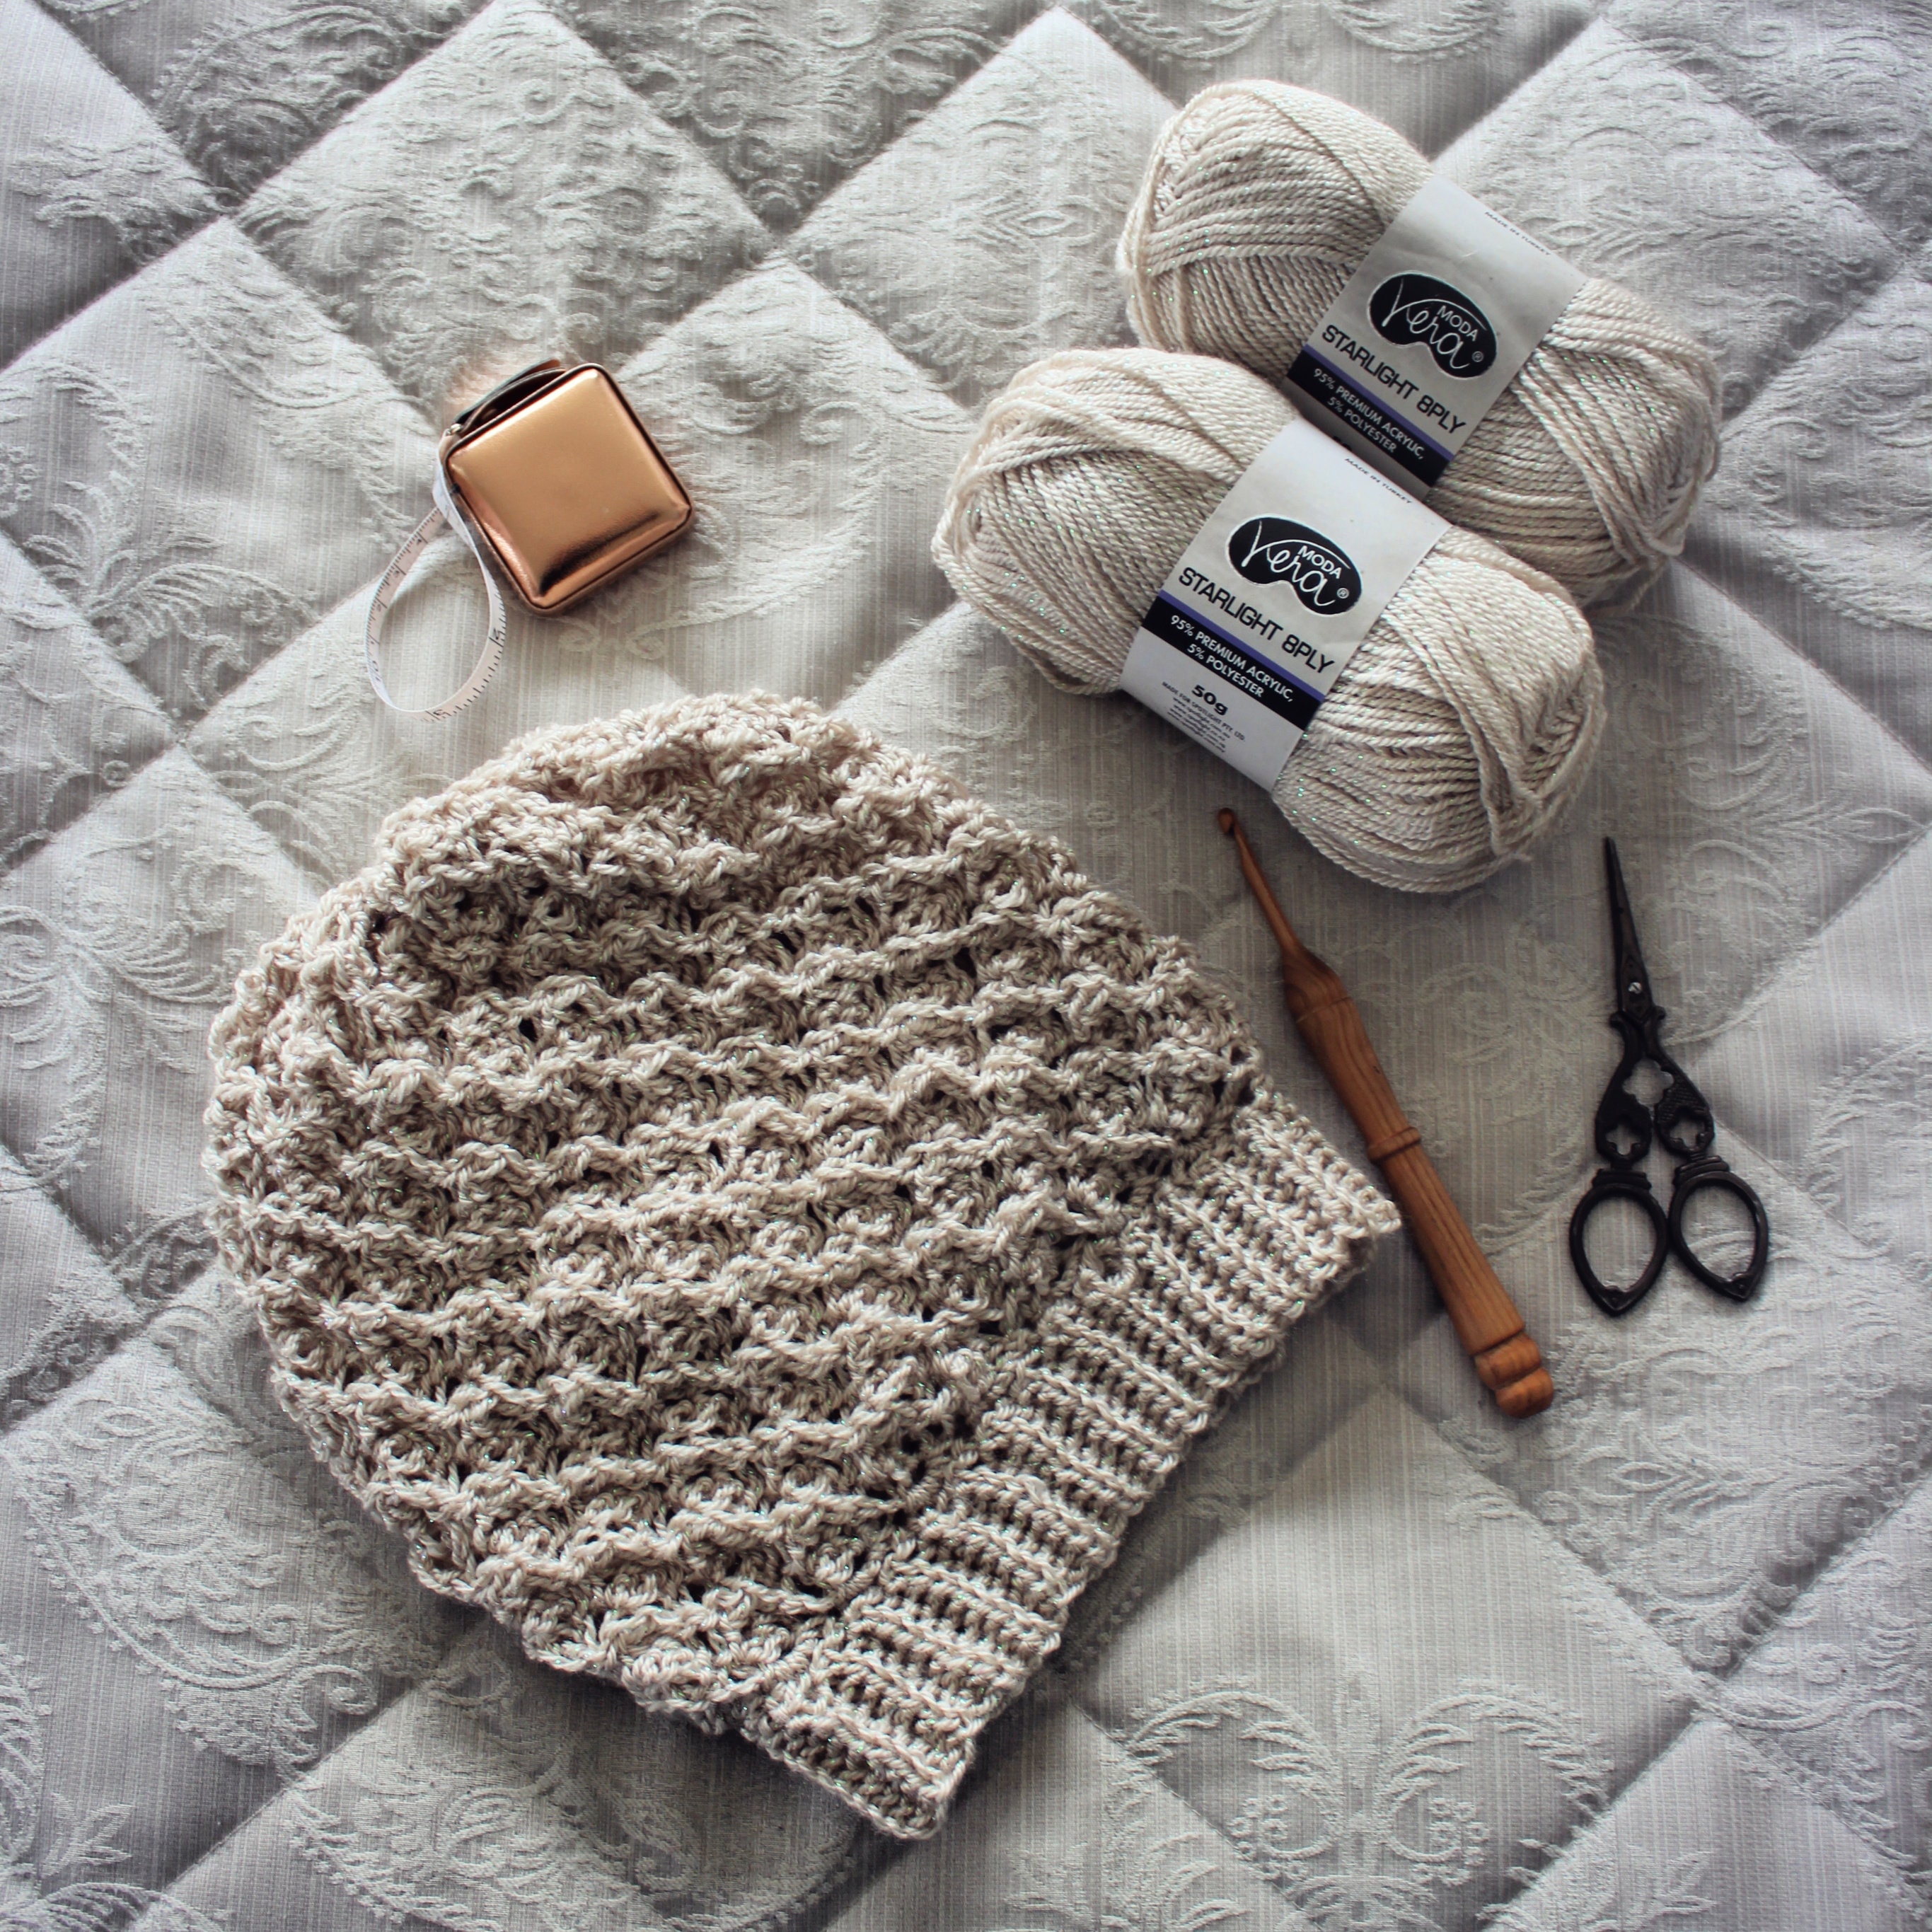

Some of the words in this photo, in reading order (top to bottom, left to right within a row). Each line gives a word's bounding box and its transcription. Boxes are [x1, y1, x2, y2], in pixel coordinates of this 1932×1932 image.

[1382, 279, 1488, 369] Vera
[1437, 306, 1479, 342] MODA
[1321, 324, 1419, 400] STARLIGHT
[1417, 390, 1468, 434] 8PLY
[1312, 369, 1336, 391] 95%
[1336, 383, 1384, 422] PREMIUM
[1382, 417, 1425, 461] ACRYLIC,
[1326, 397, 1344, 414] 5%
[1343, 407, 1398, 453] POLYESTER
[1344, 458, 1370, 475] MADE
[1382, 482, 1413, 504] TURKEY
[1241, 519, 1351, 607] Vera
[1297, 545, 1342, 579] MODA
[1178, 566, 1284, 642] STARLIGHT
[1281, 632, 1336, 674] 8PLY
[1170, 614, 1196, 637] 95%
[1195, 630, 1247, 669] PREMIUM
[1245, 663, 1295, 703] ACRYLIC,
[1186, 643, 1205, 661] 5%
[1204, 654, 1265, 698] POLYESTER
[1162, 681, 1179, 695] MADE
[1179, 693, 1191, 703] FOR
[1191, 700, 1222, 725] SPOTLIGHT
[1191, 684, 1229, 716] 50g
